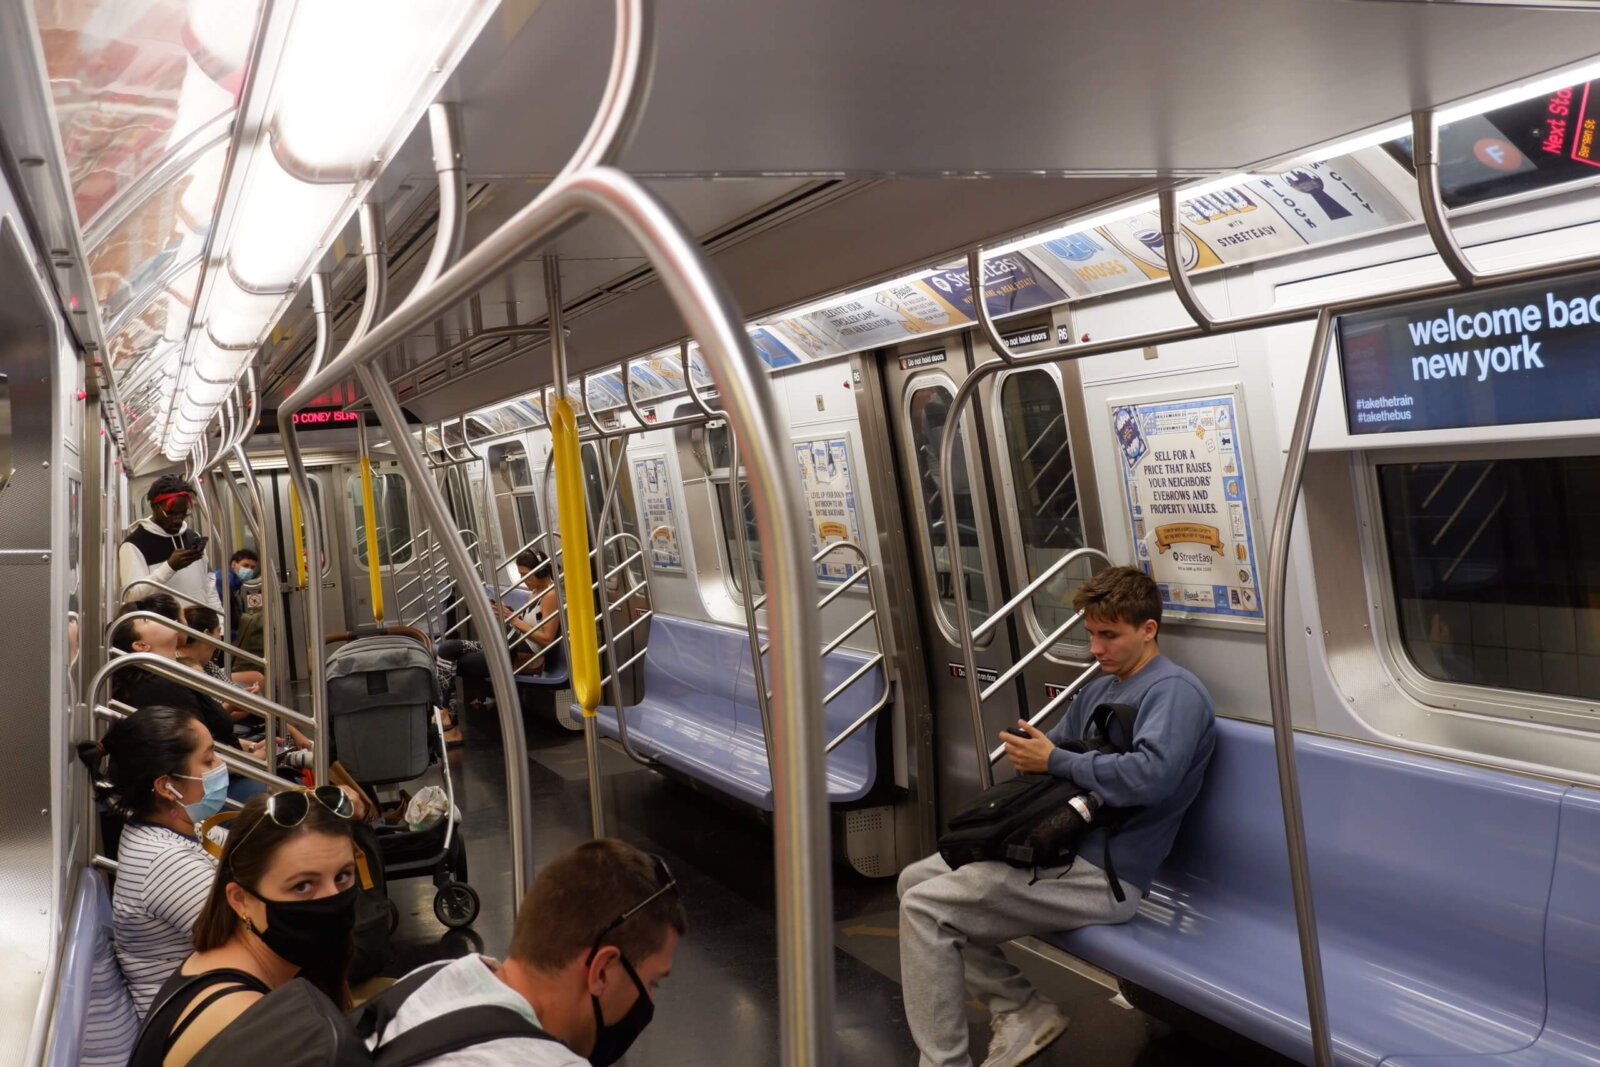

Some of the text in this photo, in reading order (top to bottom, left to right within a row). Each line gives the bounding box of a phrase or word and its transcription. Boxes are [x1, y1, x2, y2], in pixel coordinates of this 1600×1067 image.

[1542, 86, 1574, 155] Next Sto
[1485, 145, 1504, 164] F
[1329, 171, 1374, 214] CITY
[1260, 179, 1317, 229] NLOCK
[1217, 225, 1277, 247] STREETEASY
[945, 257, 1026, 287] StrtEasy
[1073, 259, 1128, 281] HOUSES
[1408, 303, 1542, 346] welcome
[1010, 337, 1018, 346] not
[1019, 334, 1031, 344] hold
[1031, 332, 1047, 342] doors
[1058, 328, 1067, 340] R6
[1412, 335, 1545, 382] new york
[1356, 394, 1414, 410] #takethetrain
[301, 412, 331, 423] CONEY
[334, 410, 359, 421] ISLAN
[1358, 409, 1411, 423] #takethebus
[1155, 449, 1195, 461] SELL FOR A
[1144, 462, 1212, 475] PRICE THAT RAISES
[1148, 478, 1167, 488] YOUR
[1153, 489, 1208, 501] EYEBROWS AND
[1150, 504, 1185, 514] PROPERTY
[1187, 503, 1218, 514] VALUES.
[1179, 552, 1212, 565] StreetEasy
